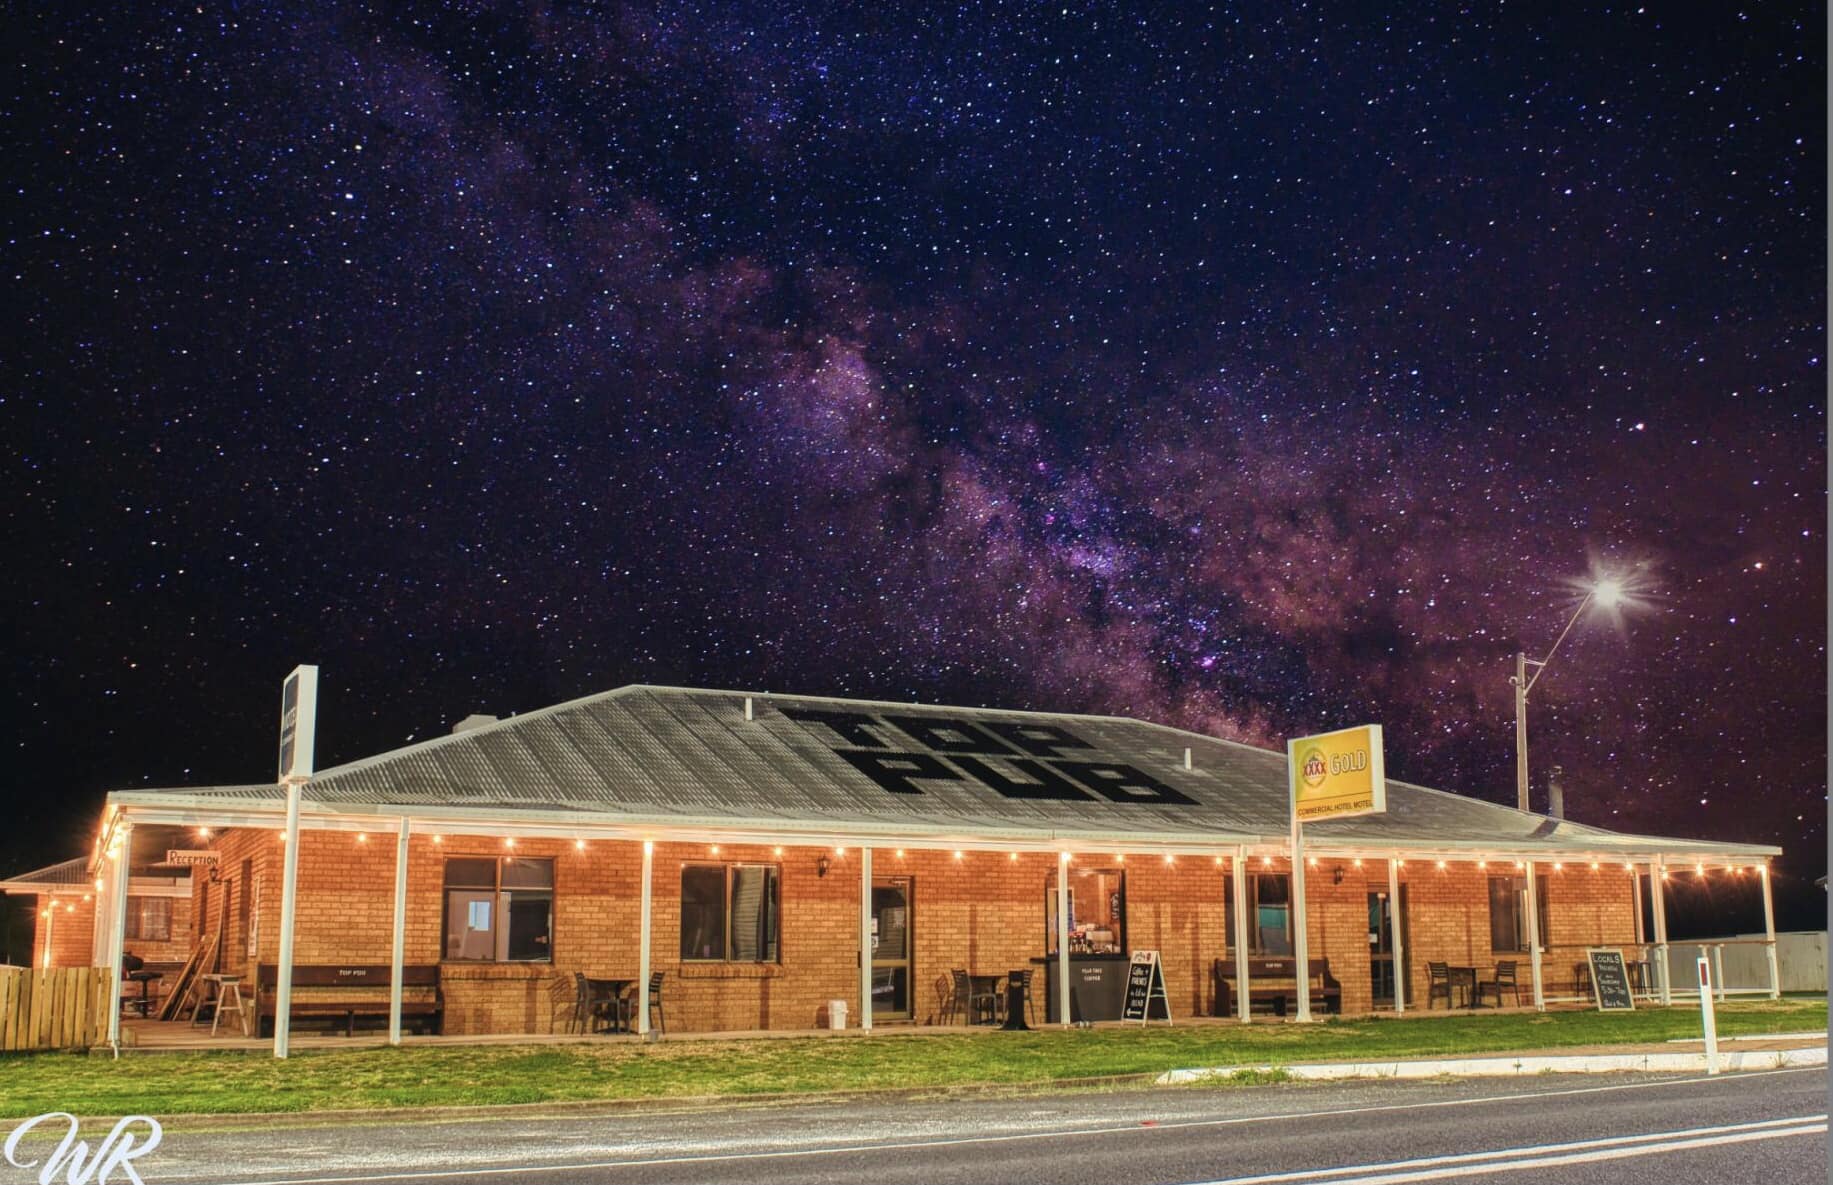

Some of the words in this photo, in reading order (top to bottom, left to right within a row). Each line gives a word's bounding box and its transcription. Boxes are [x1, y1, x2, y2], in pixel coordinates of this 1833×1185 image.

[776, 708, 1097, 758] TOP
[834, 748, 1202, 806] PUB
[1303, 761, 1327, 777] XXXX
[1330, 750, 1368, 775] GOLD
[1297, 804, 1334, 816] COMMERCIAL
[1334, 801, 1353, 810] HOTEL
